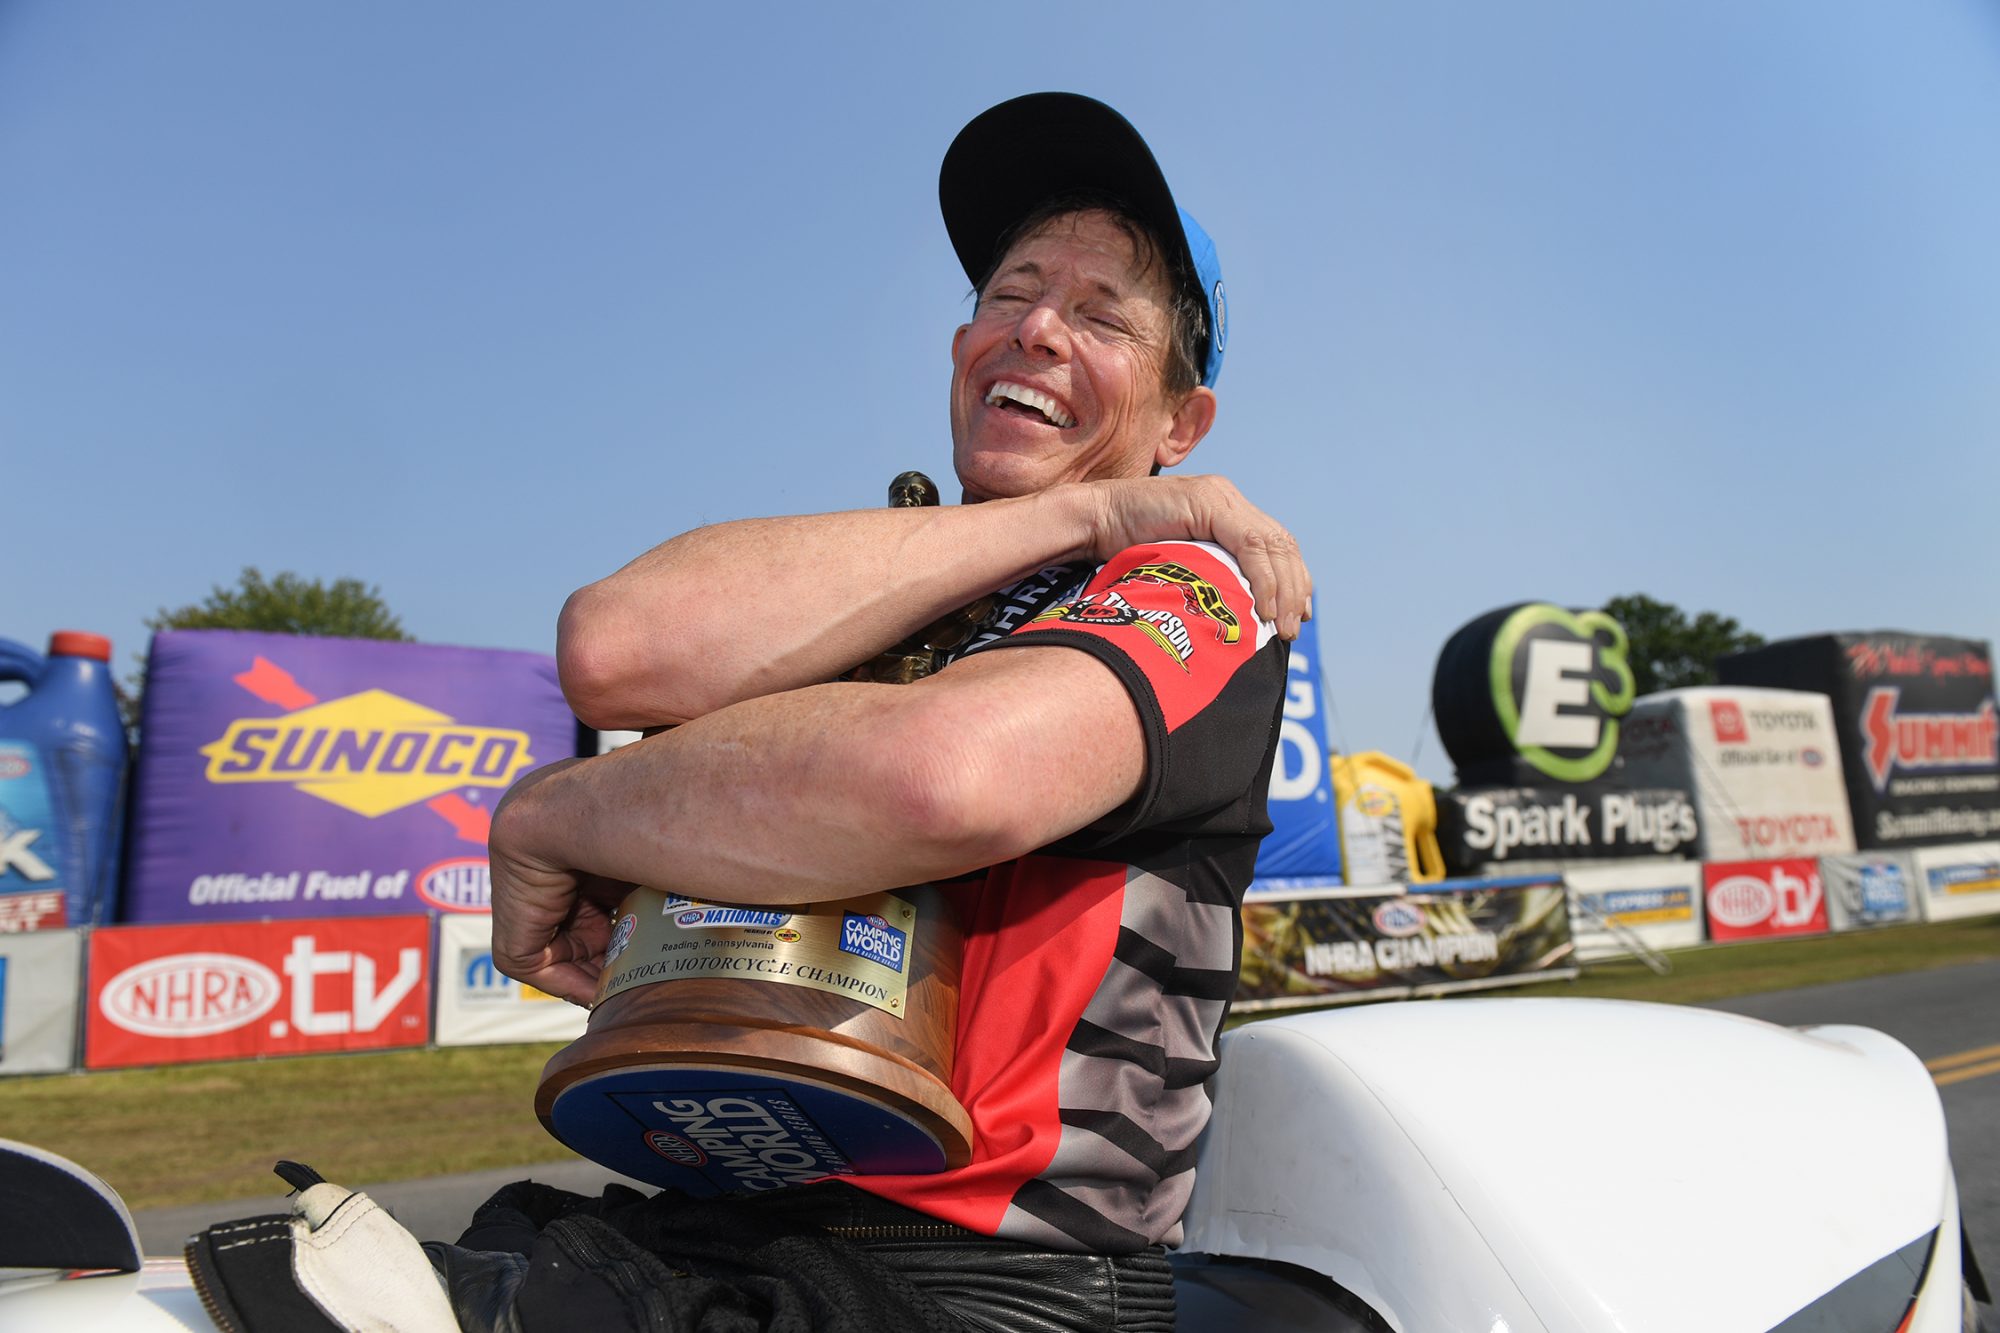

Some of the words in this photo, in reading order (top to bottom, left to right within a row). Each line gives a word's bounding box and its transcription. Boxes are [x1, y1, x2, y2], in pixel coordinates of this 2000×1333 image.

[1102, 591, 1195, 661] THMPSON
[219, 727, 513, 779] SUNOCO
[1463, 794, 1592, 859] Spark
[1602, 794, 1698, 853] Plugs
[1736, 815, 1840, 848] TOYOTA
[188, 871, 300, 905] Official
[303, 869, 373, 901] Fuel
[373, 869, 411, 899] of
[430, 867, 491, 905] NH
[680, 912, 701, 923] NHRA
[703, 909, 783, 926] NATIONALS
[846, 919, 902, 950] CAMPING
[704, 938, 775, 951] Pennsylvania
[845, 929, 901, 963] WORLD
[131, 968, 253, 1020] NHRA
[625, 960, 671, 983] STOCK
[796, 965, 888, 1001] CHAMPION
[767, 1099, 815, 1132] SERIES
[652, 1099, 788, 1191] CAMPING
[652, 1135, 698, 1161] NHRA
